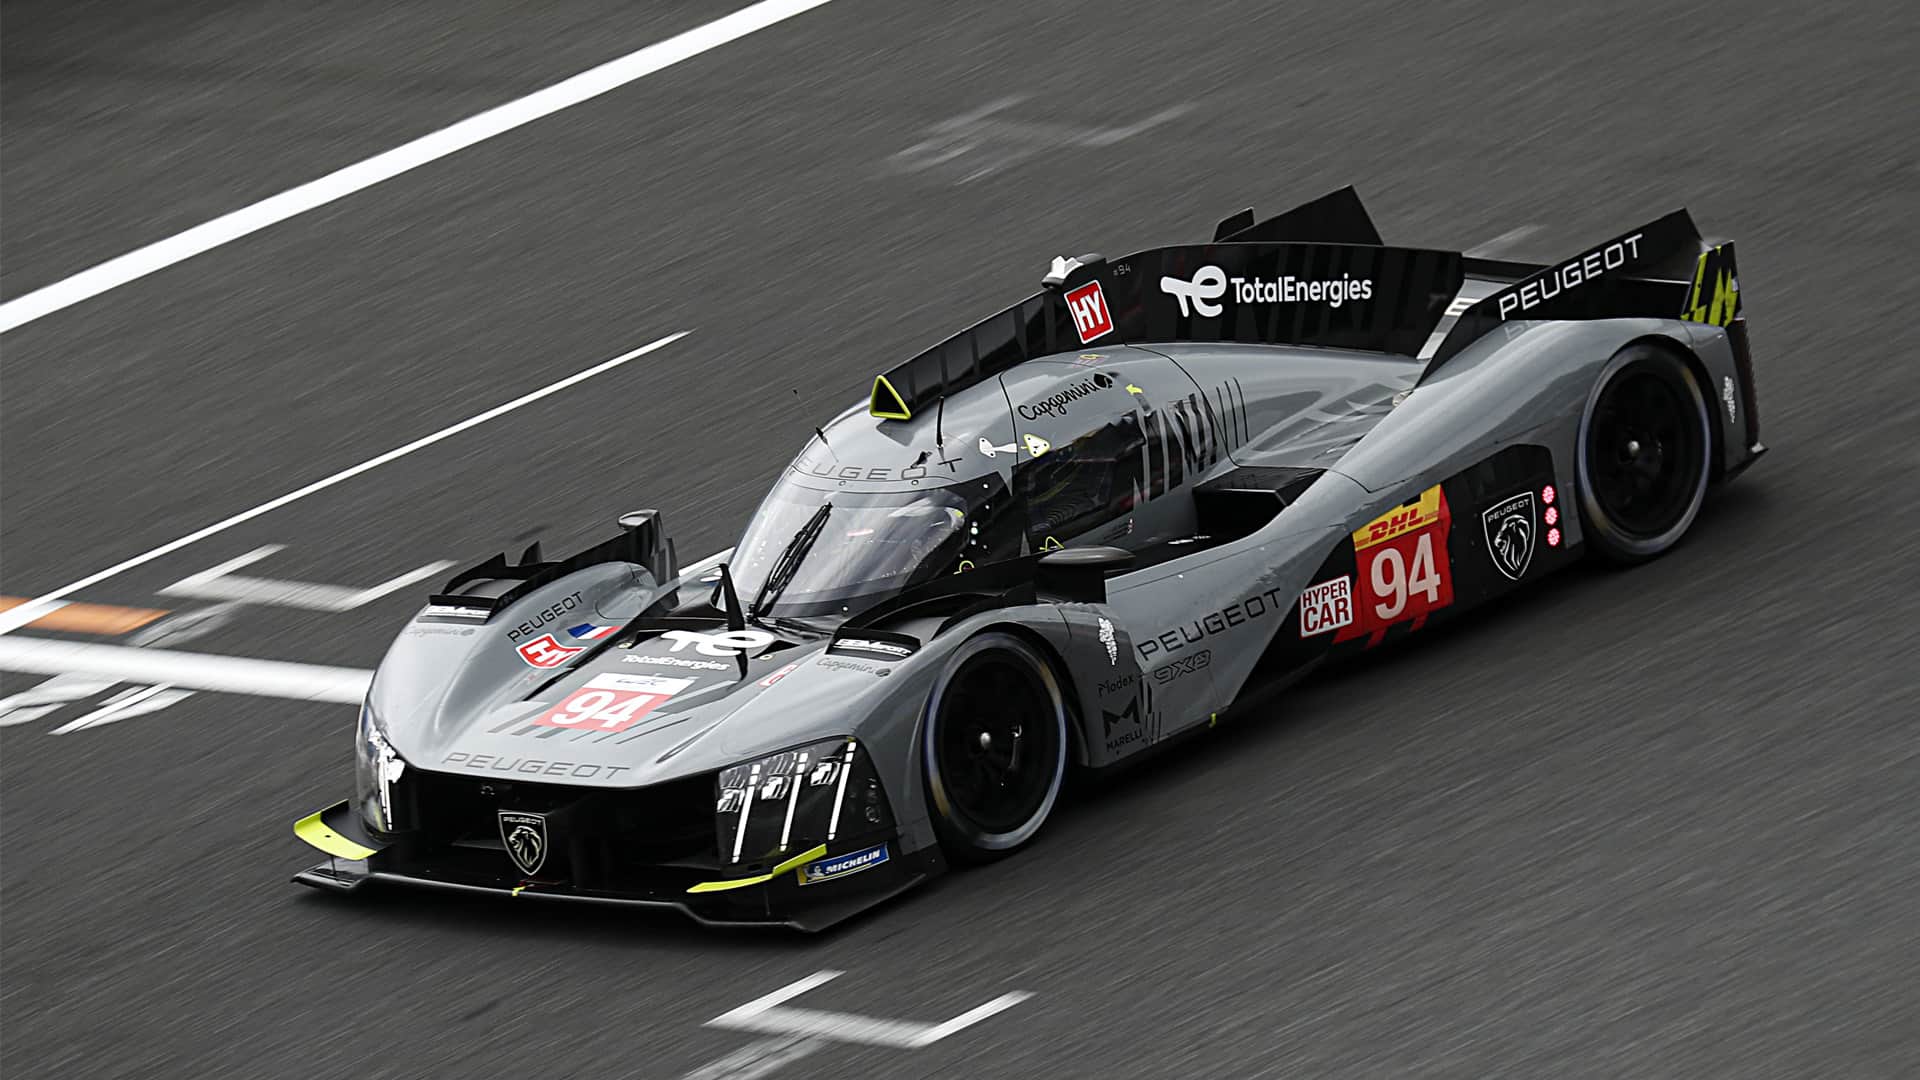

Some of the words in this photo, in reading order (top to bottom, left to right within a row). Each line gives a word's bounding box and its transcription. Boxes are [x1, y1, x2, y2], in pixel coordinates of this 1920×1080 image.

[1231, 273, 1372, 308] TotalEnergies
[1499, 233, 1643, 321] PEUGEOT
[1071, 290, 1105, 332] HY
[1018, 378, 1099, 421] Capgemini
[793, 456, 963, 480] EUGEOT
[1368, 508, 1424, 541] DHL
[1488, 498, 1530, 523] PEUGEOT
[1370, 532, 1441, 619] 94
[1303, 579, 1348, 608] HYPER
[507, 592, 583, 642] PEUGEOT
[1137, 587, 1281, 661] PEUGEOT
[1303, 597, 1350, 633] CAR
[621, 654, 731, 671] TotalEnergies
[551, 691, 637, 729] 94
[1106, 728, 1142, 752] MARELLI
[442, 751, 631, 780] PEUGEOT
[826, 849, 881, 873] MICHELIN
